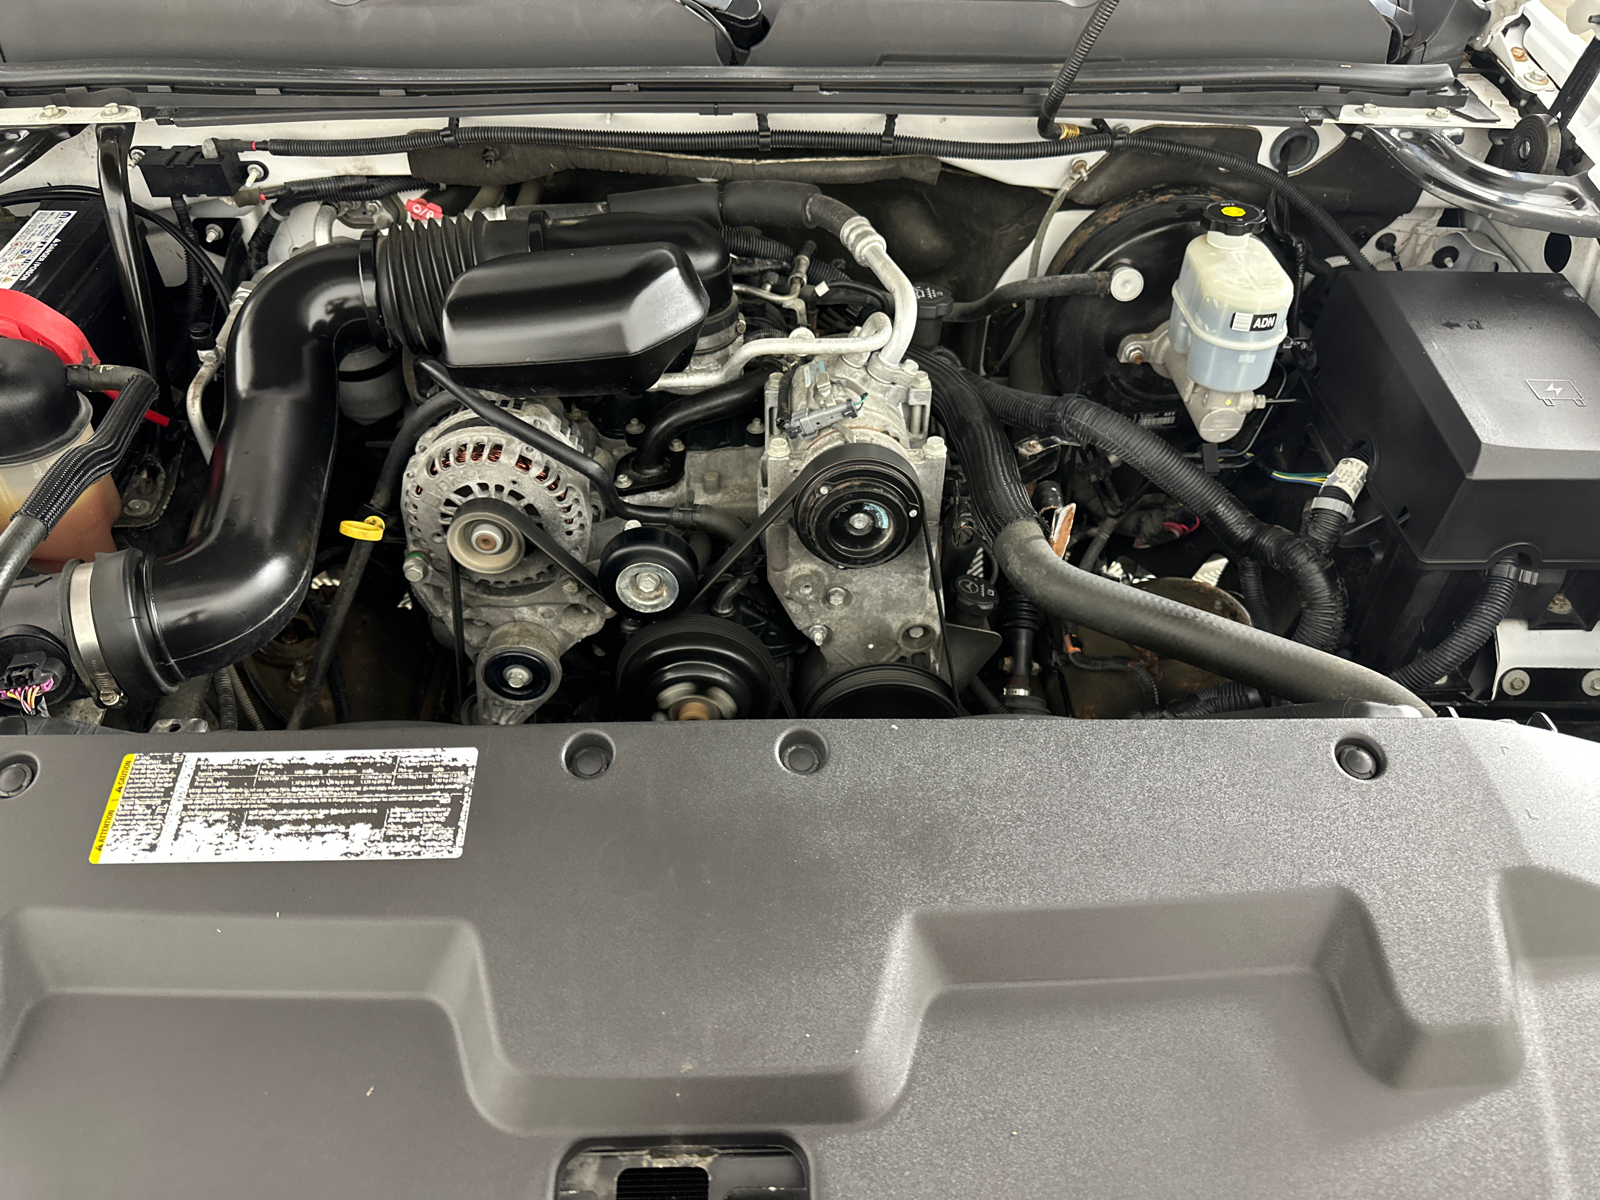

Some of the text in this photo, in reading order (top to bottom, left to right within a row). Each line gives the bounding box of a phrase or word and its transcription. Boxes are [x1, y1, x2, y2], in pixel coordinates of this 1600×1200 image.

[1253, 316, 1275, 329] ADN
[99, 761, 132, 842] ATTENTION CAUTION
